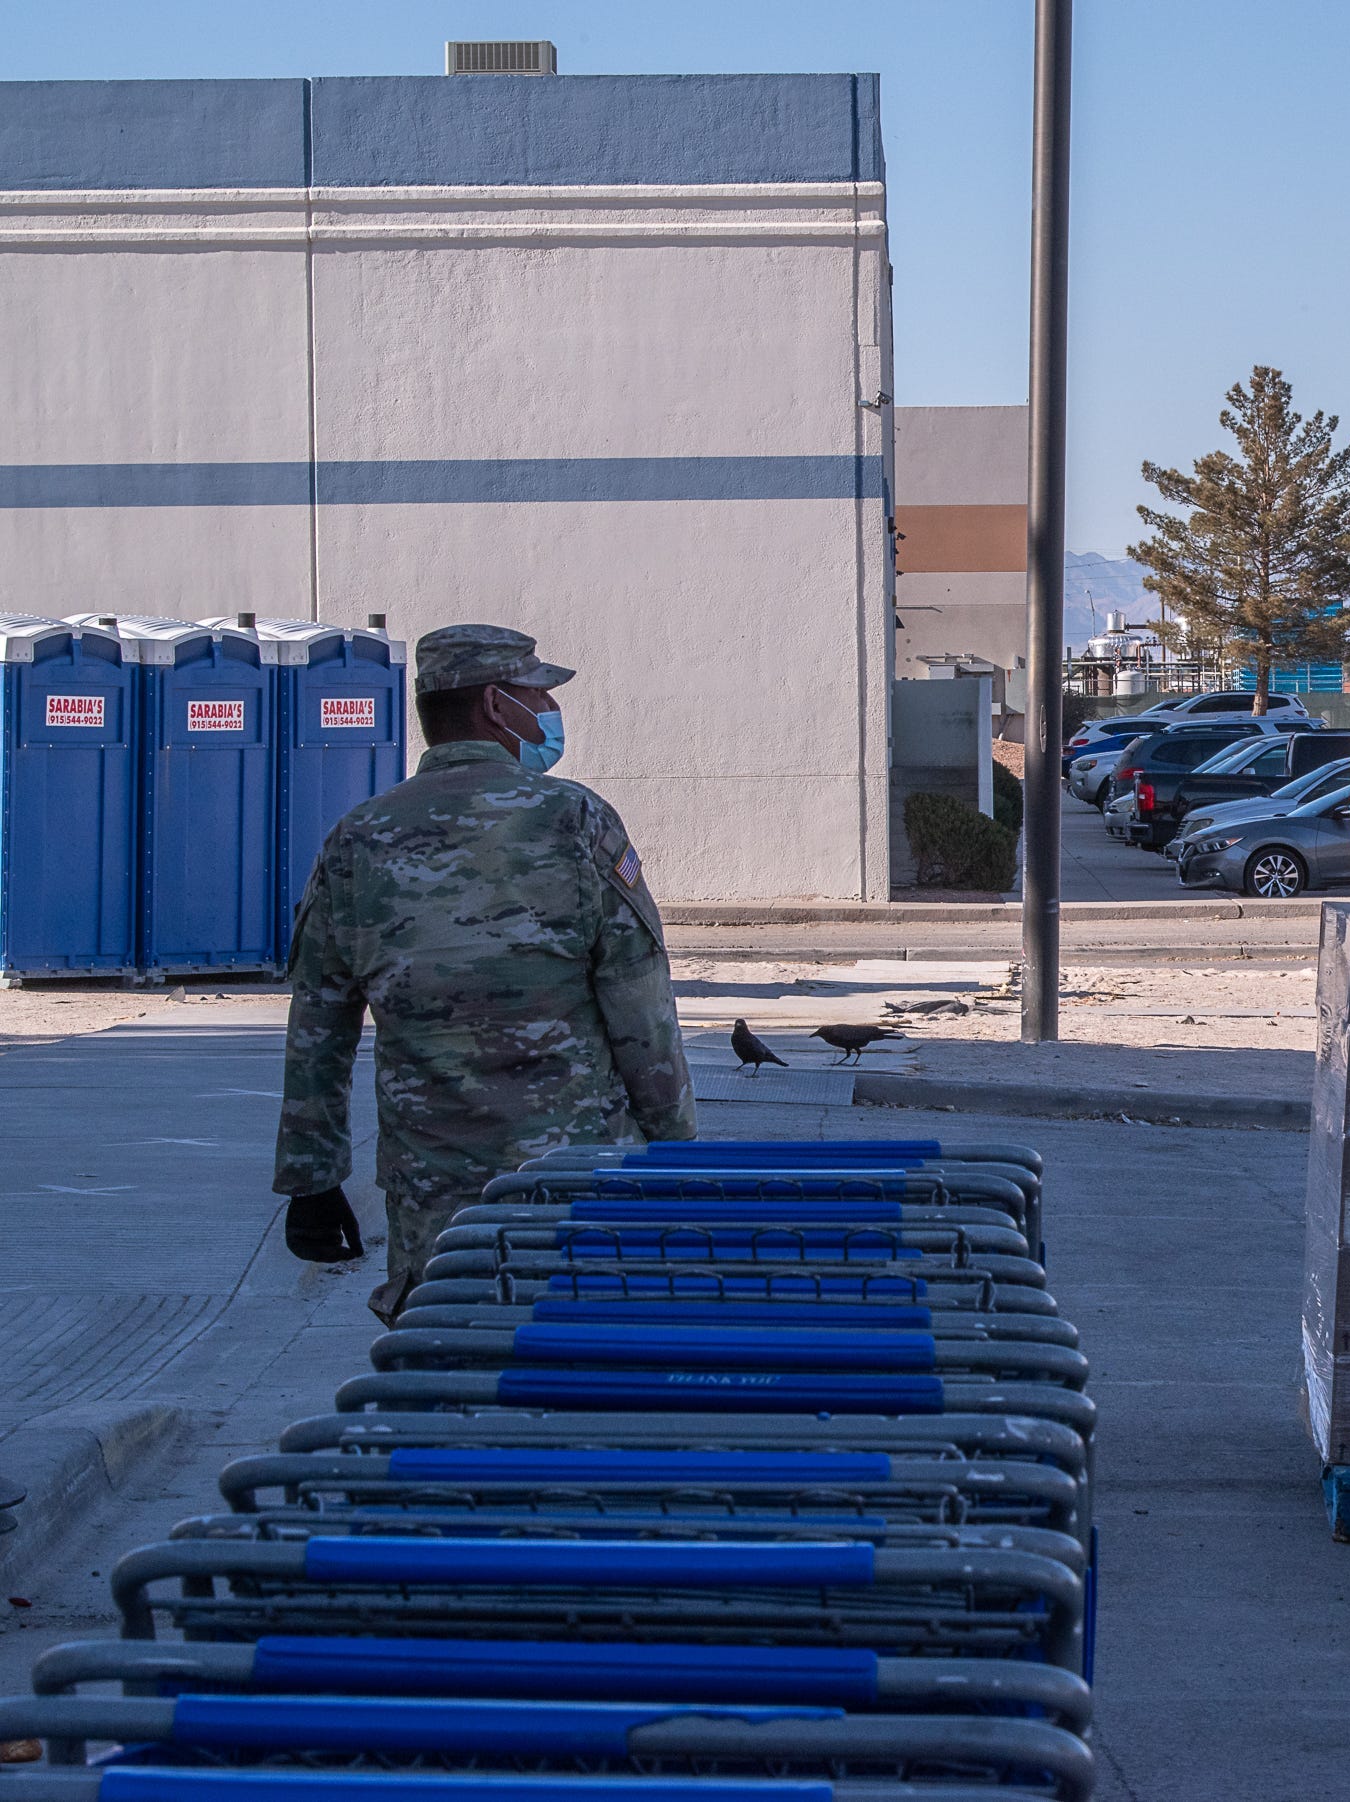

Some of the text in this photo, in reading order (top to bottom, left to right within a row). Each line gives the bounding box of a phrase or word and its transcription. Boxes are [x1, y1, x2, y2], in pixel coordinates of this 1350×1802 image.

[49, 698, 103, 714] SARABIA'S
[190, 703, 242, 719] SARABIA'S
[323, 700, 373, 715] SARABIA'S
